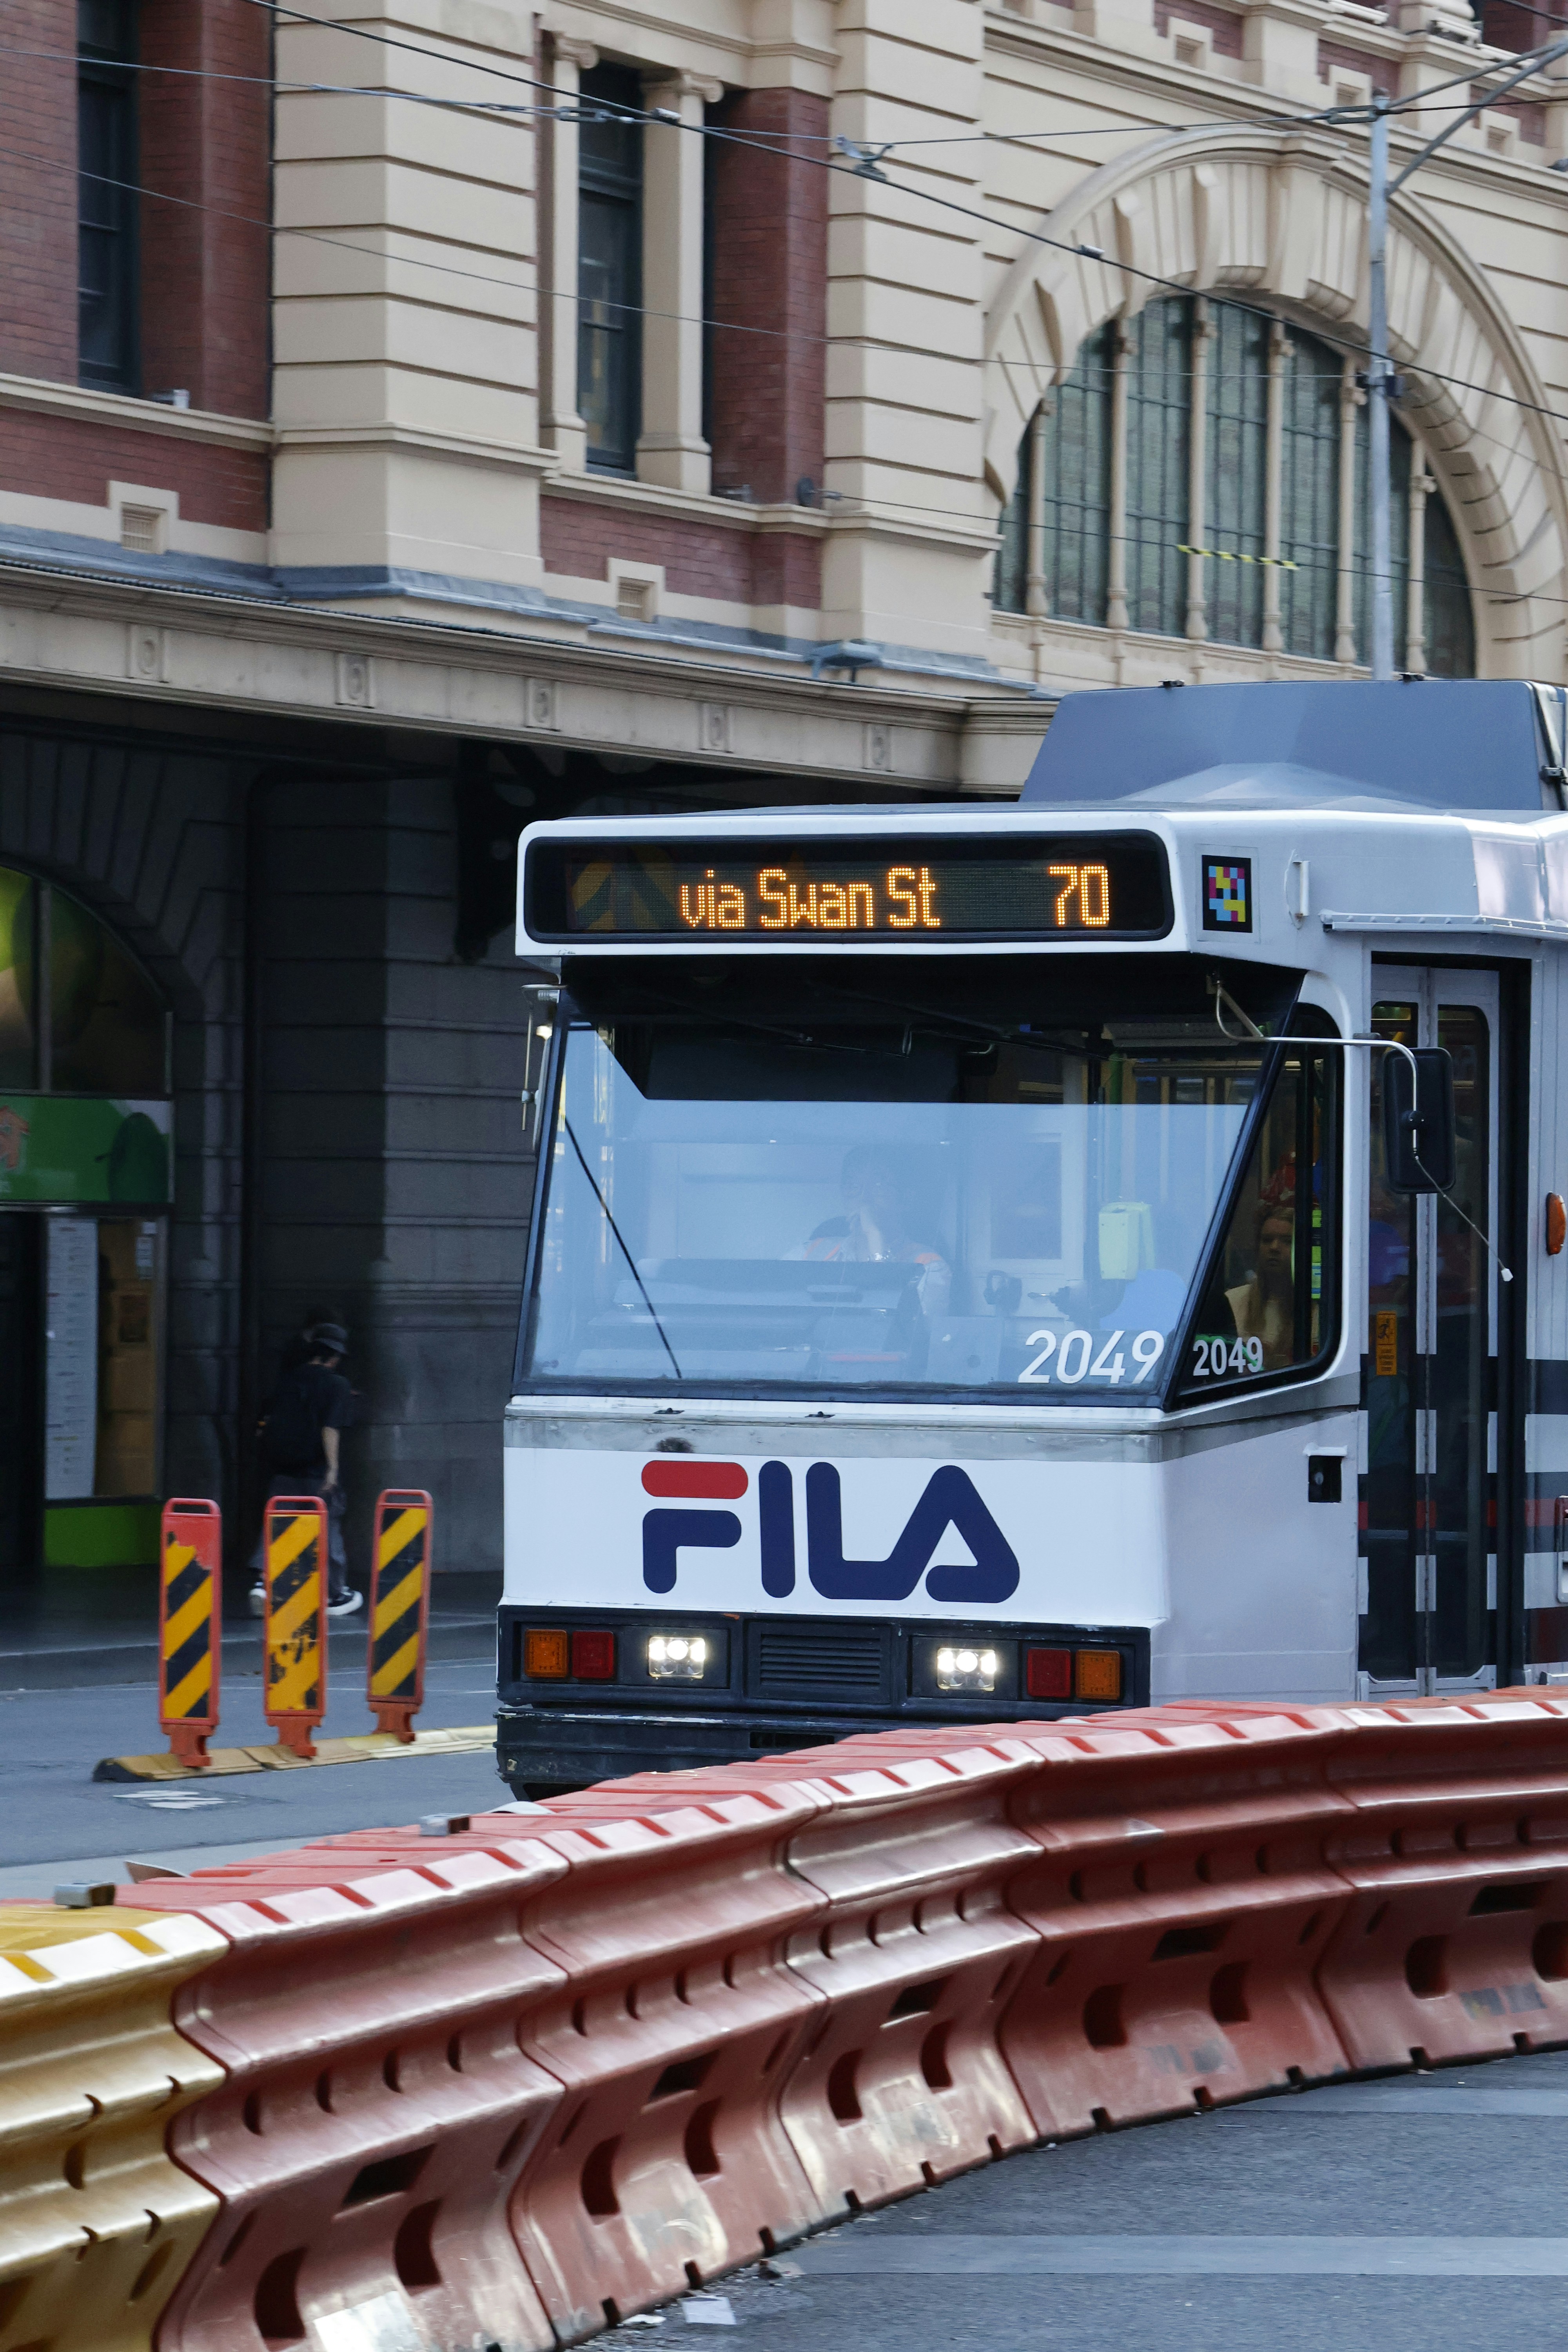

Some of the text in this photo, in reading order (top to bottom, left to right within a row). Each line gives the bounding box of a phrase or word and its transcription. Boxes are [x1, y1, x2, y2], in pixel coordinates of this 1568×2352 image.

[681, 867, 940, 927] via Swan St
[1049, 866, 1110, 926] 70
[1018, 1329, 1165, 1384] 2049
[1192, 1336, 1264, 1376] 2049
[641, 1460, 1020, 1604] FILA
